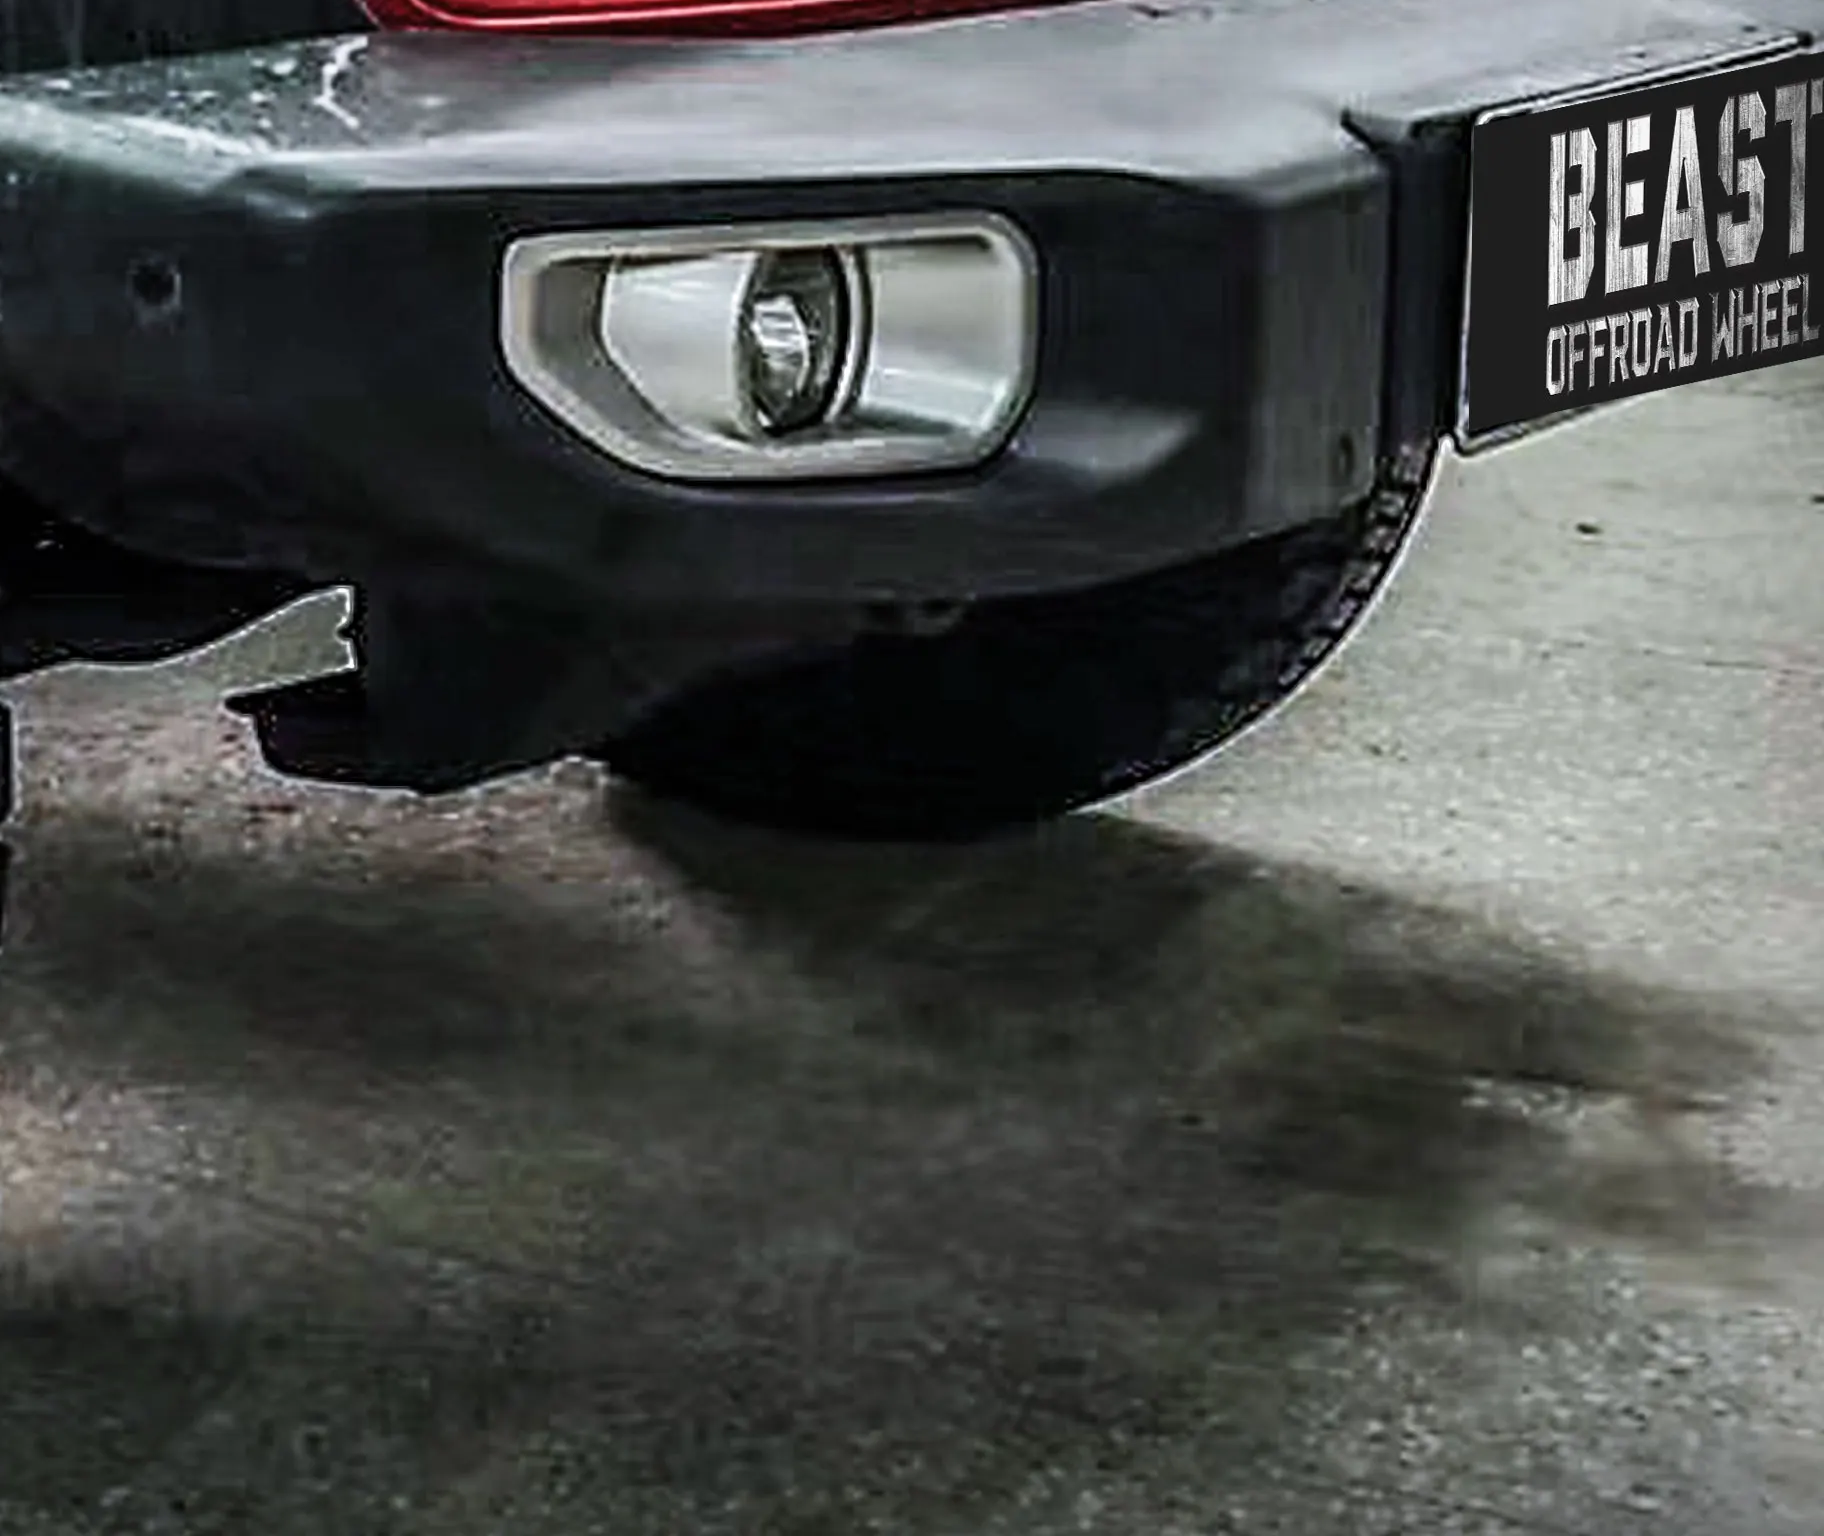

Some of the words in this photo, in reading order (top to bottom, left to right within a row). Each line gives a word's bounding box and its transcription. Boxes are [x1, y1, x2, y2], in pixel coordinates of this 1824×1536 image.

[1547, 77, 1824, 308] BEAST
[1545, 296, 1699, 397] OFFROAD
[1710, 273, 1821, 364] WHEEL
